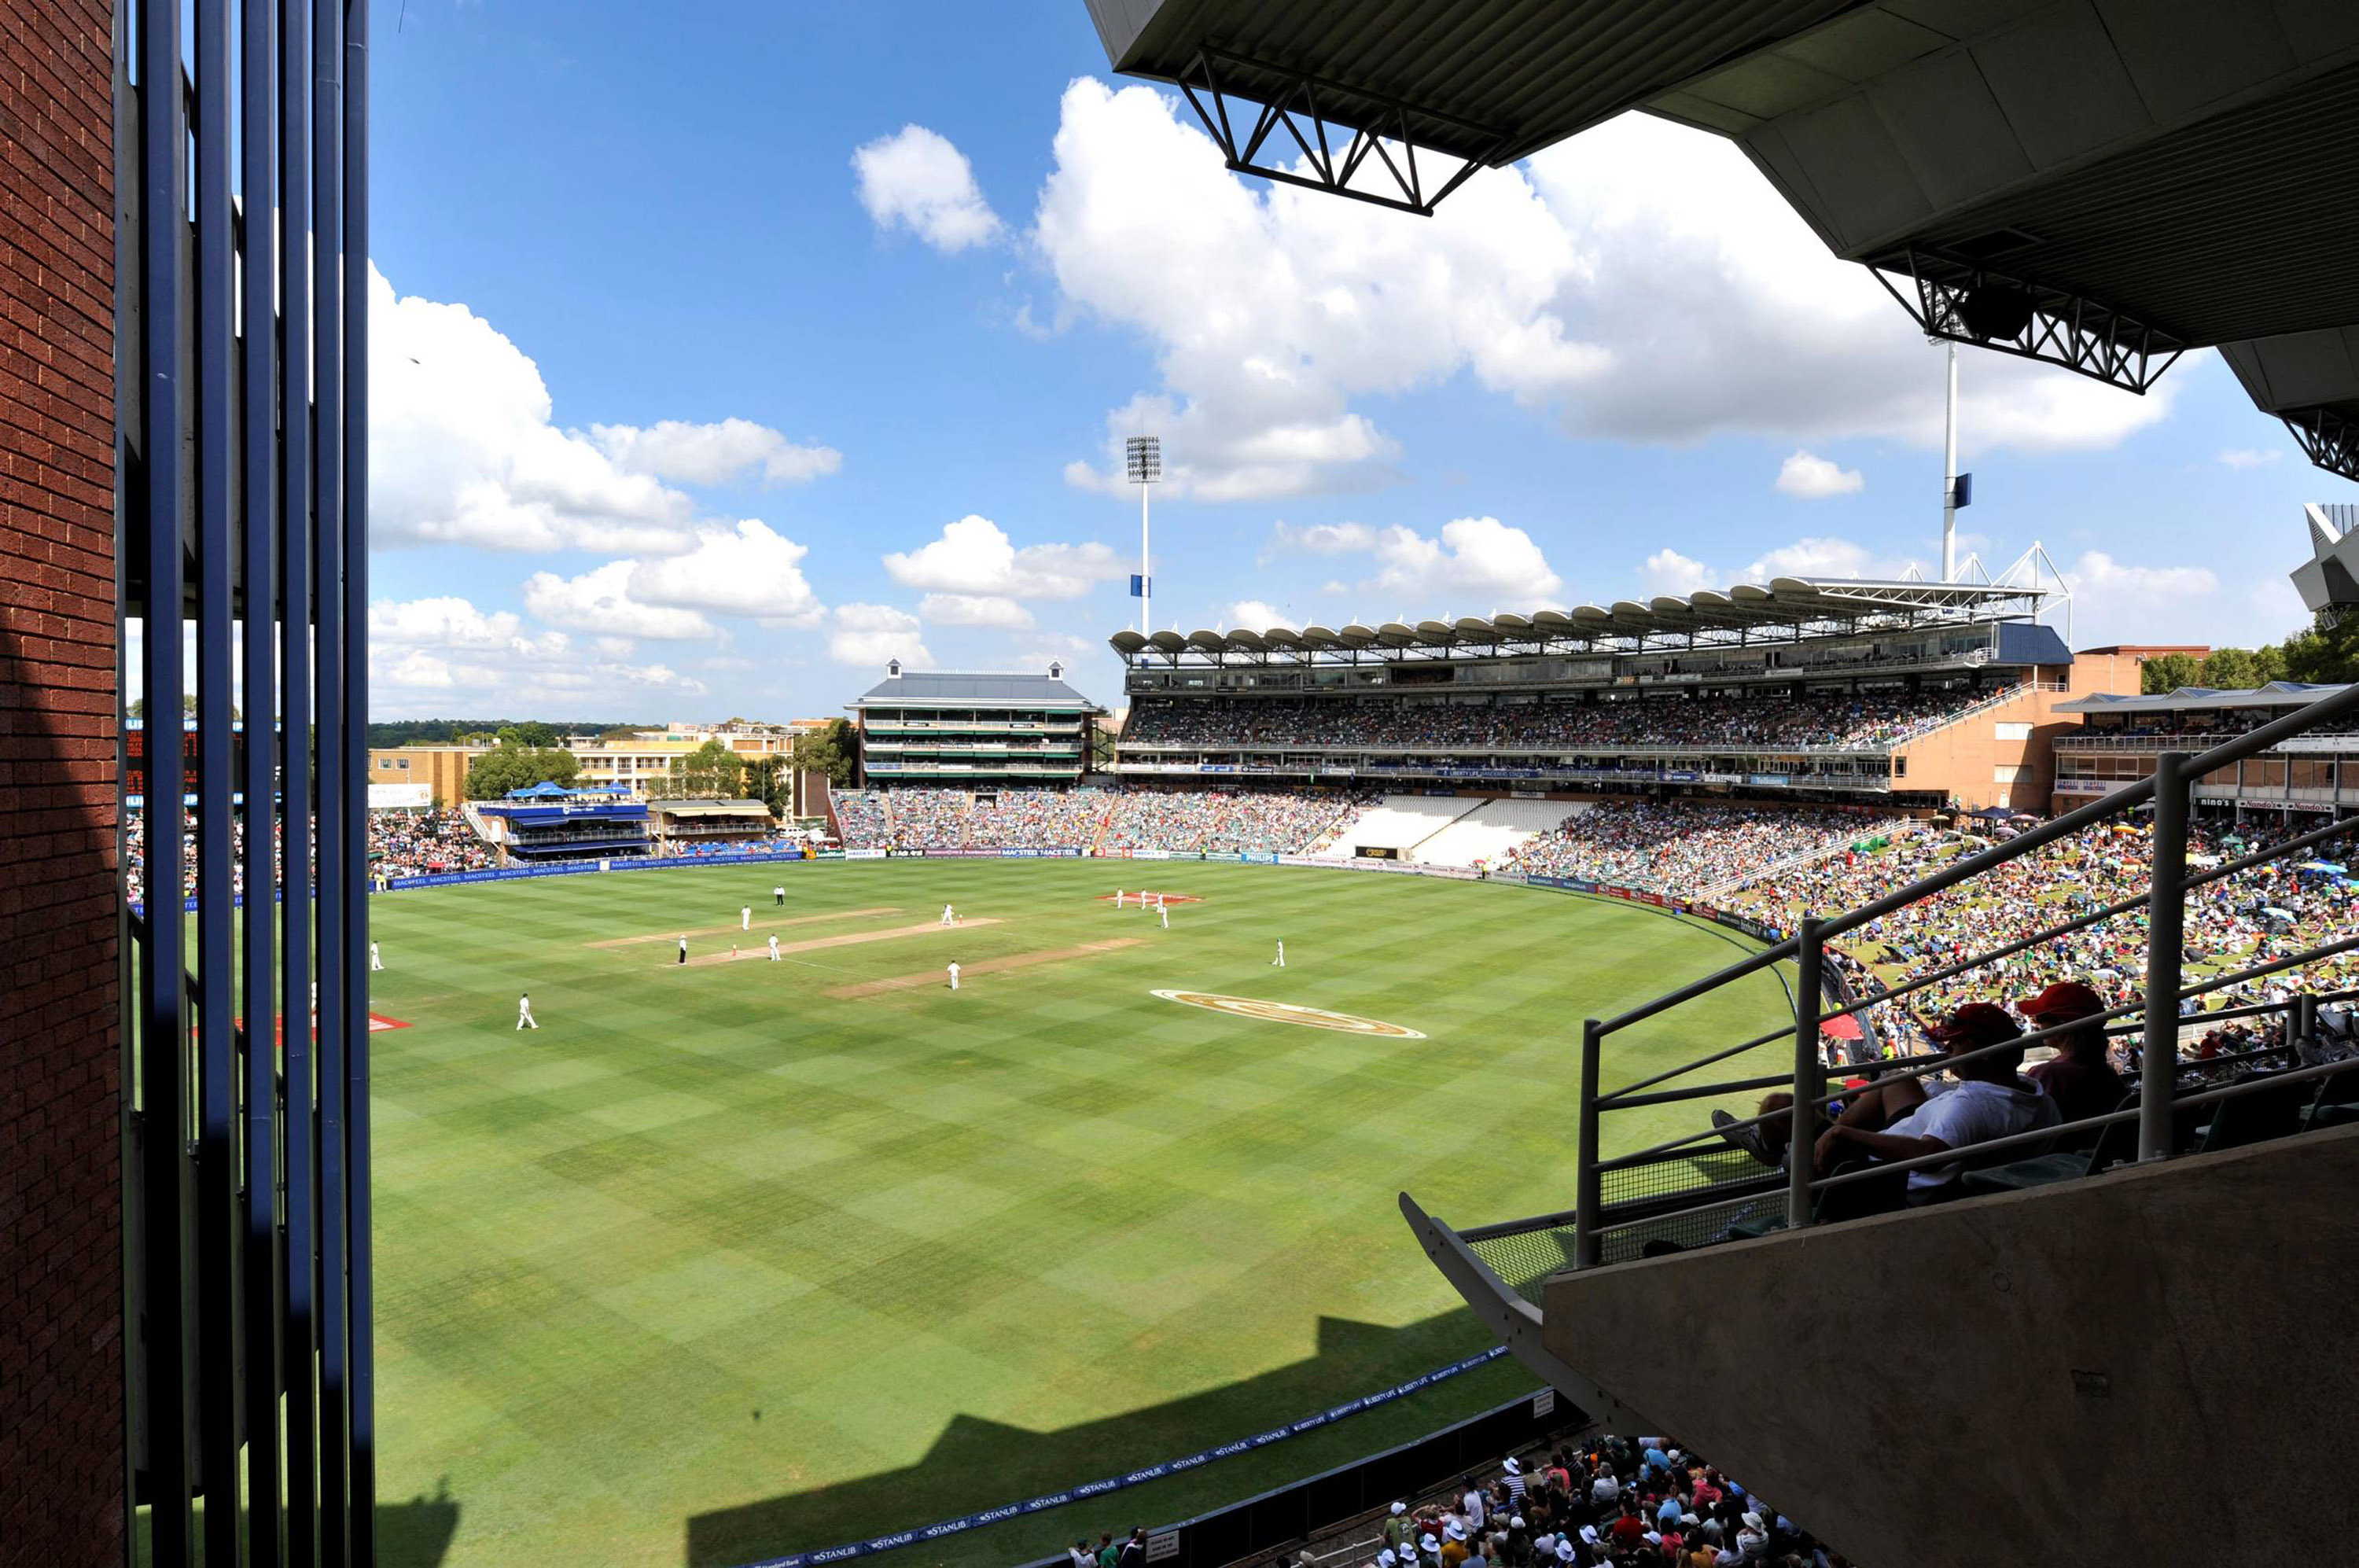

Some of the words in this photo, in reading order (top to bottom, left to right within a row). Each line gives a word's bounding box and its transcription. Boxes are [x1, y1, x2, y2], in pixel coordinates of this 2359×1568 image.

[2293, 803, 2325, 812] Nando's
[1246, 853, 1274, 862] PHILIPS
[1402, 1381, 1419, 1392] LIBERTY
[1419, 1376, 1428, 1386] LIFE
[1369, 1393, 1386, 1404] LIBERTY
[1386, 1389, 1397, 1399] LIFE
[1334, 1406, 1352, 1415] LIBERTY
[1352, 1402, 1361, 1411] LIFE
[1297, 1420, 1316, 1430] LIBERTY
[1316, 1416, 1325, 1425] LIFE
[1260, 1430, 1286, 1443] STANLIB
[1219, 1441, 1247, 1456] STANLIB
[1177, 1455, 1205, 1469] STANLIB
[1132, 1467, 1162, 1481] STANLIB
[1085, 1480, 1116, 1494] STANLIB
[1036, 1495, 1068, 1507] STANLIB
[984, 1506, 1018, 1521] STANLIB
[932, 1521, 967, 1535] STANLIB
[877, 1533, 912, 1548] STANLIB
[820, 1547, 857, 1560] STANLIB
